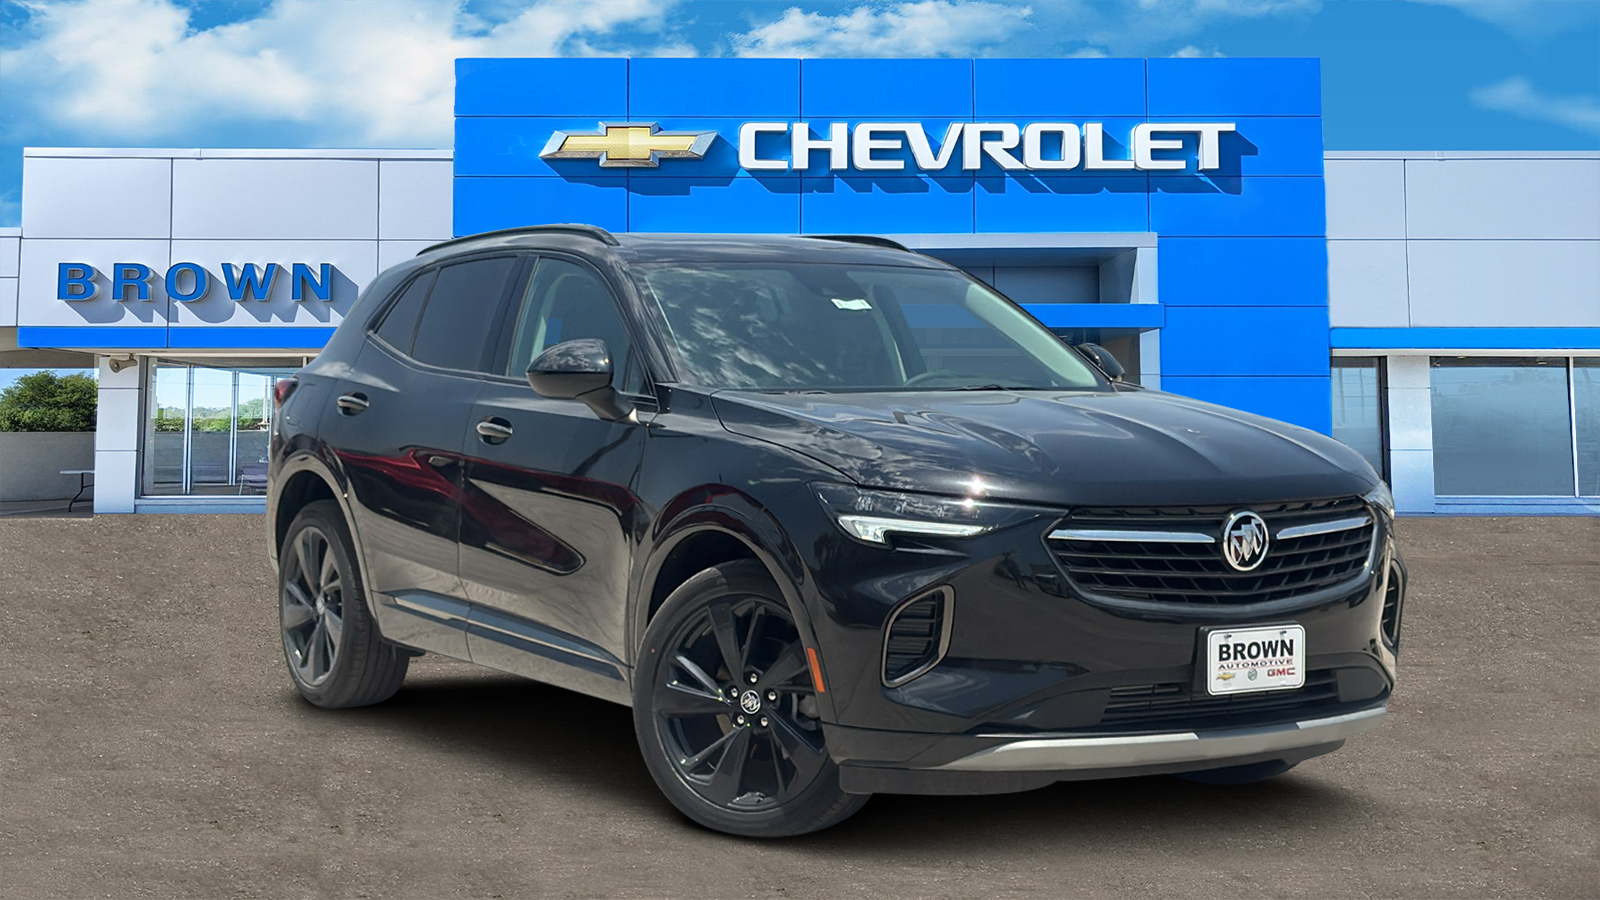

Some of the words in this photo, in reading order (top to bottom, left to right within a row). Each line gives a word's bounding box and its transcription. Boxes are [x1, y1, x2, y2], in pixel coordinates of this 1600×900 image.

[738, 122, 1236, 170] CHEVROLET
[57, 262, 334, 301] BROWN
[1219, 639, 1294, 662] BROWN
[1218, 659, 1293, 670] AUTOMOTIVE
[1267, 667, 1295, 677] GMC
